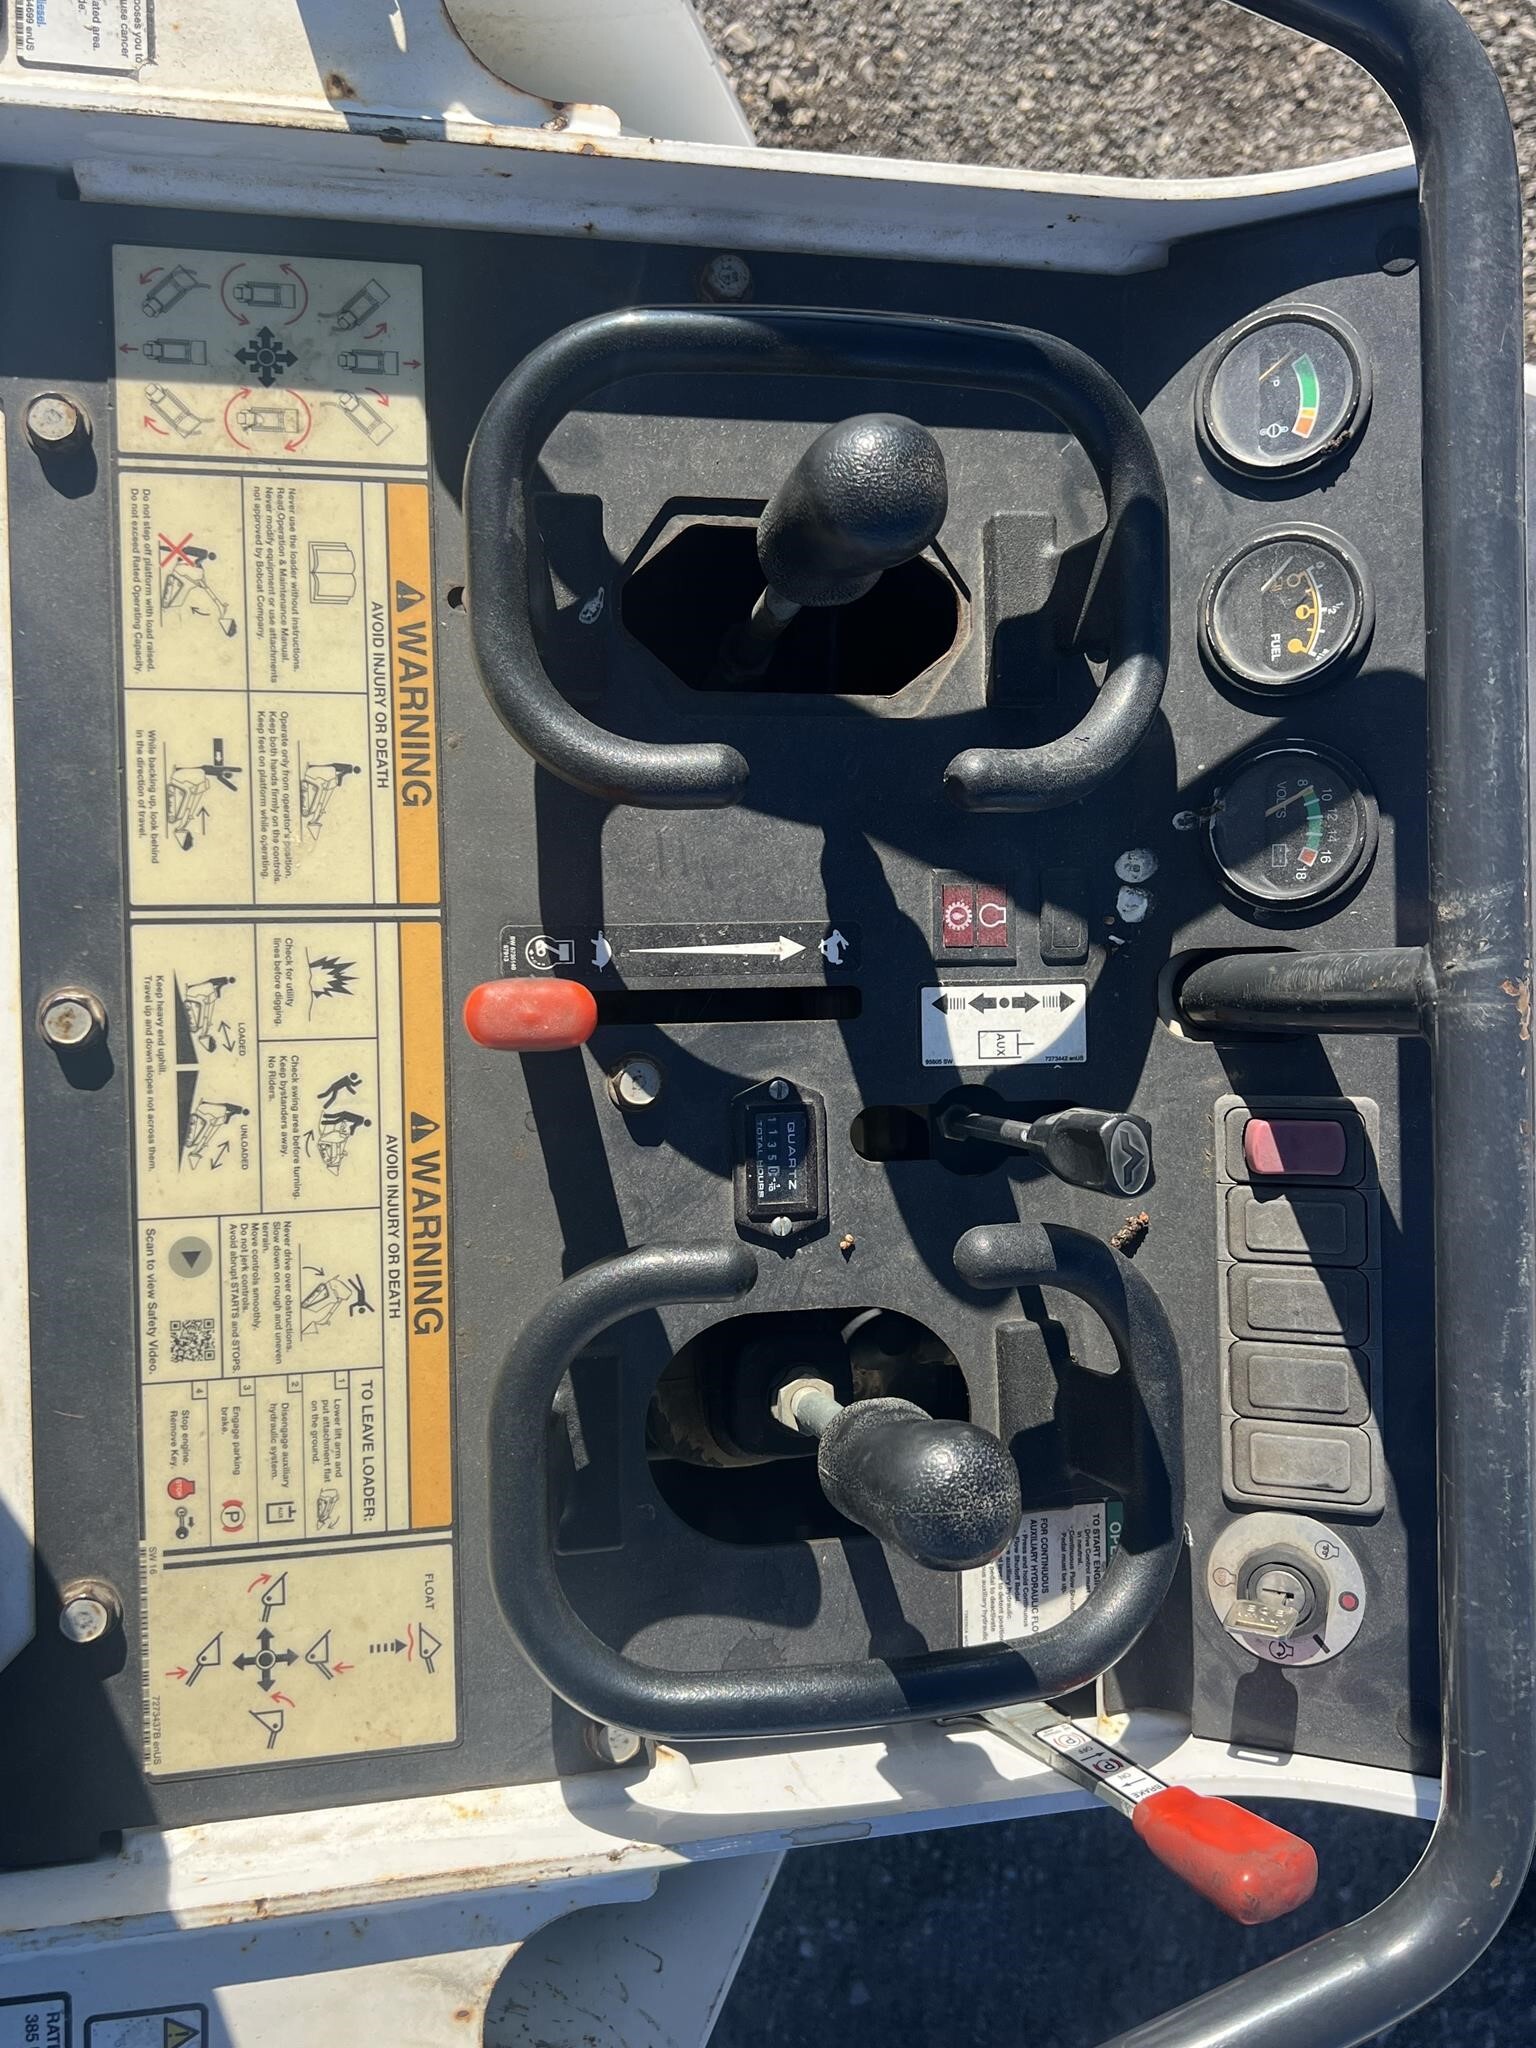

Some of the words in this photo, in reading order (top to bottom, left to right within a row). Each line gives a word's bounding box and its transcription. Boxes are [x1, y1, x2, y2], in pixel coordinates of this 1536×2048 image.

[26, 26, 34, 51] enUS
[92, 26, 100, 51] area.
[132, 32, 142, 50] you
[135, 54, 144, 63] to
[143, 488, 151, 501] Do
[277, 487, 285, 510] Read
[288, 488, 297, 513] Never
[143, 503, 151, 518] not
[142, 521, 152, 540] step
[276, 511, 287, 556] Operation
[290, 534, 298, 548] the
[144, 543, 152, 555] off
[143, 557, 153, 595] platform
[290, 551, 299, 579] loader
[145, 598, 154, 617] with
[280, 568, 289, 625] Maintenance
[291, 581, 300, 614] without
[146, 619, 155, 639] load
[372, 601, 385, 647] AVOID
[147, 641, 156, 671] raised.
[281, 628, 290, 662] Manual.
[292, 617, 301, 671] instructions.
[1270, 633, 1281, 662] FUEL
[373, 653, 387, 707] INJURY
[268, 711, 280, 734] Keep
[375, 712, 387, 733] OR
[397, 620, 433, 806] WARNING
[148, 730, 157, 754] While
[270, 736, 279, 756] both
[147, 757, 158, 792] backing
[270, 759, 279, 785] hands
[376, 738, 389, 787] DEATH
[1297, 779, 1308, 787] 8
[1321, 788, 1332, 801] 10
[148, 795, 157, 809] up,
[270, 788, 280, 813] firmly
[150, 811, 159, 830] look
[272, 815, 279, 826] on
[1326, 808, 1338, 821] 12
[151, 833, 160, 863] behind
[272, 829, 281, 843] the
[1326, 830, 1337, 842] 14
[273, 846, 282, 884] controls.
[1320, 850, 1332, 864] 16
[1295, 866, 1307, 880] 18
[274, 937, 282, 958] lines
[285, 937, 294, 965] Check
[155, 975, 165, 998] Keep
[274, 960, 283, 989] before
[286, 968, 294, 980] for
[285, 982, 294, 1006] utility
[155, 1000, 166, 1026] heavy
[273, 991, 284, 1026] digging.
[158, 1029, 166, 1045] end
[238, 1022, 246, 1056] LOADED
[996, 1033, 1006, 1057] AUX
[156, 1048, 167, 1074] uphill.
[268, 1056, 276, 1068] No
[279, 1055, 288, 1078] Keep
[291, 1055, 300, 1082] Check
[269, 1070, 277, 1101] Riders.
[291, 1085, 300, 1111] swing
[279, 1080, 289, 1129] bystanders
[241, 1124, 249, 1169] UNLOADED
[280, 1131, 288, 1156] away.
[293, 1135, 301, 1163] before
[386, 1134, 399, 1179] AVOID
[787, 1122, 797, 1190] QUARTZ
[292, 1166, 302, 1199] turning.
[756, 1160, 764, 1198] HOURS
[387, 1184, 400, 1238] INJURY
[146, 1228, 157, 1256] Scan
[230, 1224, 238, 1248] Avoid
[251, 1222, 260, 1246] Move
[283, 1221, 292, 1246] Never
[412, 1149, 444, 1334] WARNING
[147, 1259, 156, 1270] to
[229, 1251, 239, 1280] abrupt
[284, 1249, 293, 1270] drive
[388, 1243, 400, 1264] OR
[252, 1249, 261, 1285] controls
[147, 1273, 157, 1298] view
[389, 1269, 401, 1318] DEATH
[231, 1282, 240, 1318] STARTS
[251, 1287, 262, 1330] smoothly.
[146, 1302, 158, 1336] Safety
[232, 1321, 240, 1337] and
[285, 1294, 294, 1352] obstructions.
[149, 1339, 159, 1374] Video.
[232, 1339, 241, 1374] STOPS.
[362, 1379, 374, 1400] TO
[322, 1399, 330, 1413] put
[334, 1398, 342, 1425] Lower
[170, 1410, 179, 1447] Remove
[180, 1409, 191, 1430] Stop
[221, 1407, 230, 1434] brake.
[231, 1406, 241, 1439] Engage
[268, 1403, 279, 1443] hydraulic
[280, 1402, 290, 1449] Disengage
[362, 1405, 374, 1451] LEAVE
[323, 1416, 333, 1466] attachment
[335, 1428, 343, 1439] lift
[170, 1449, 179, 1468] Key.
[181, 1433, 191, 1465] engine.
[232, 1442, 242, 1475] parking
[269, 1446, 279, 1479] system.
[281, 1451, 291, 1487] auxiliary
[324, 1468, 332, 1482] flat
[335, 1461, 343, 1477] and
[363, 1456, 375, 1521] LOADER:
[1040, 1518, 1048, 1535] FOR
[1092, 1513, 1100, 1526] TO
[149, 1546, 157, 1561] SW
[1030, 1520, 1038, 1562] AUXILIARY
[150, 1564, 158, 1574] 16
[1041, 1537, 1049, 1594] CONTINUOUS
[425, 1573, 435, 1609] FLOAT
[1031, 1565, 1039, 1613] HYDRAULIC
[153, 1696, 161, 1739] 7273437B
[153, 1741, 162, 1765] enUS
[1130, 1784, 1162, 1799] BRAKE
[25, 2014, 40, 2042] 385
